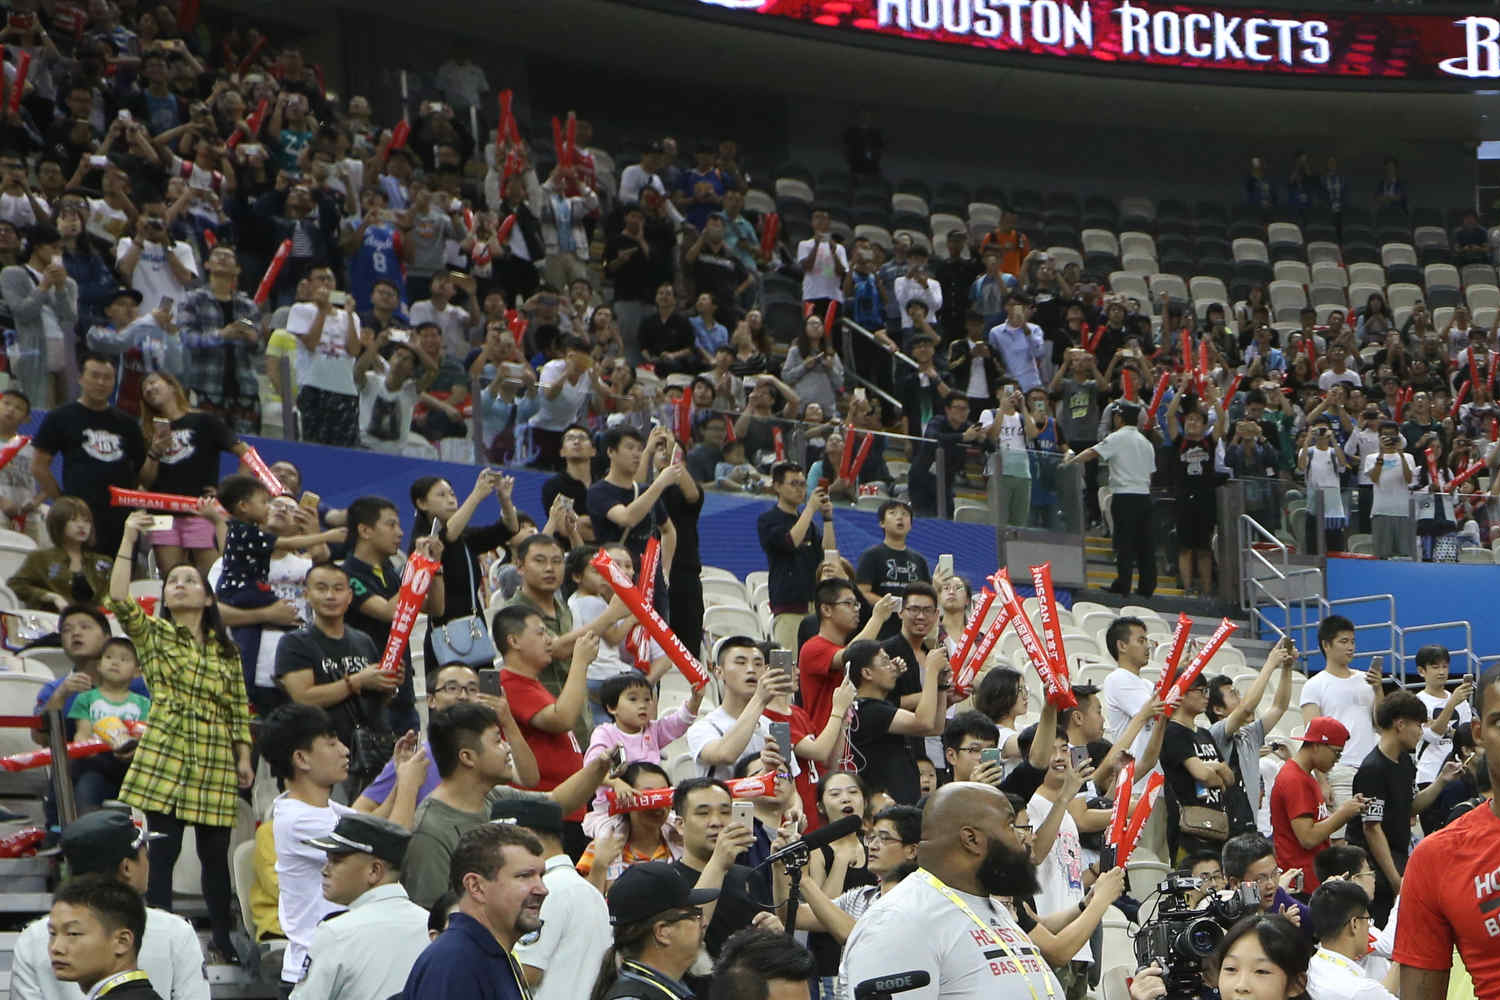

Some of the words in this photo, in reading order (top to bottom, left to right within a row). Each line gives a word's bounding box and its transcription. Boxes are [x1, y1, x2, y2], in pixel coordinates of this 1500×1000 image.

[876, 0, 1094, 48] HOUSTON
[1113, 0, 1330, 65] ROCKETS
[966, 592, 988, 631] NISSAN
[1032, 572, 1051, 623] NISSAN
[383, 636, 403, 671] SSAN
[670, 633, 708, 682] NISSAN
[1199, 622, 1230, 657] NISSAN
